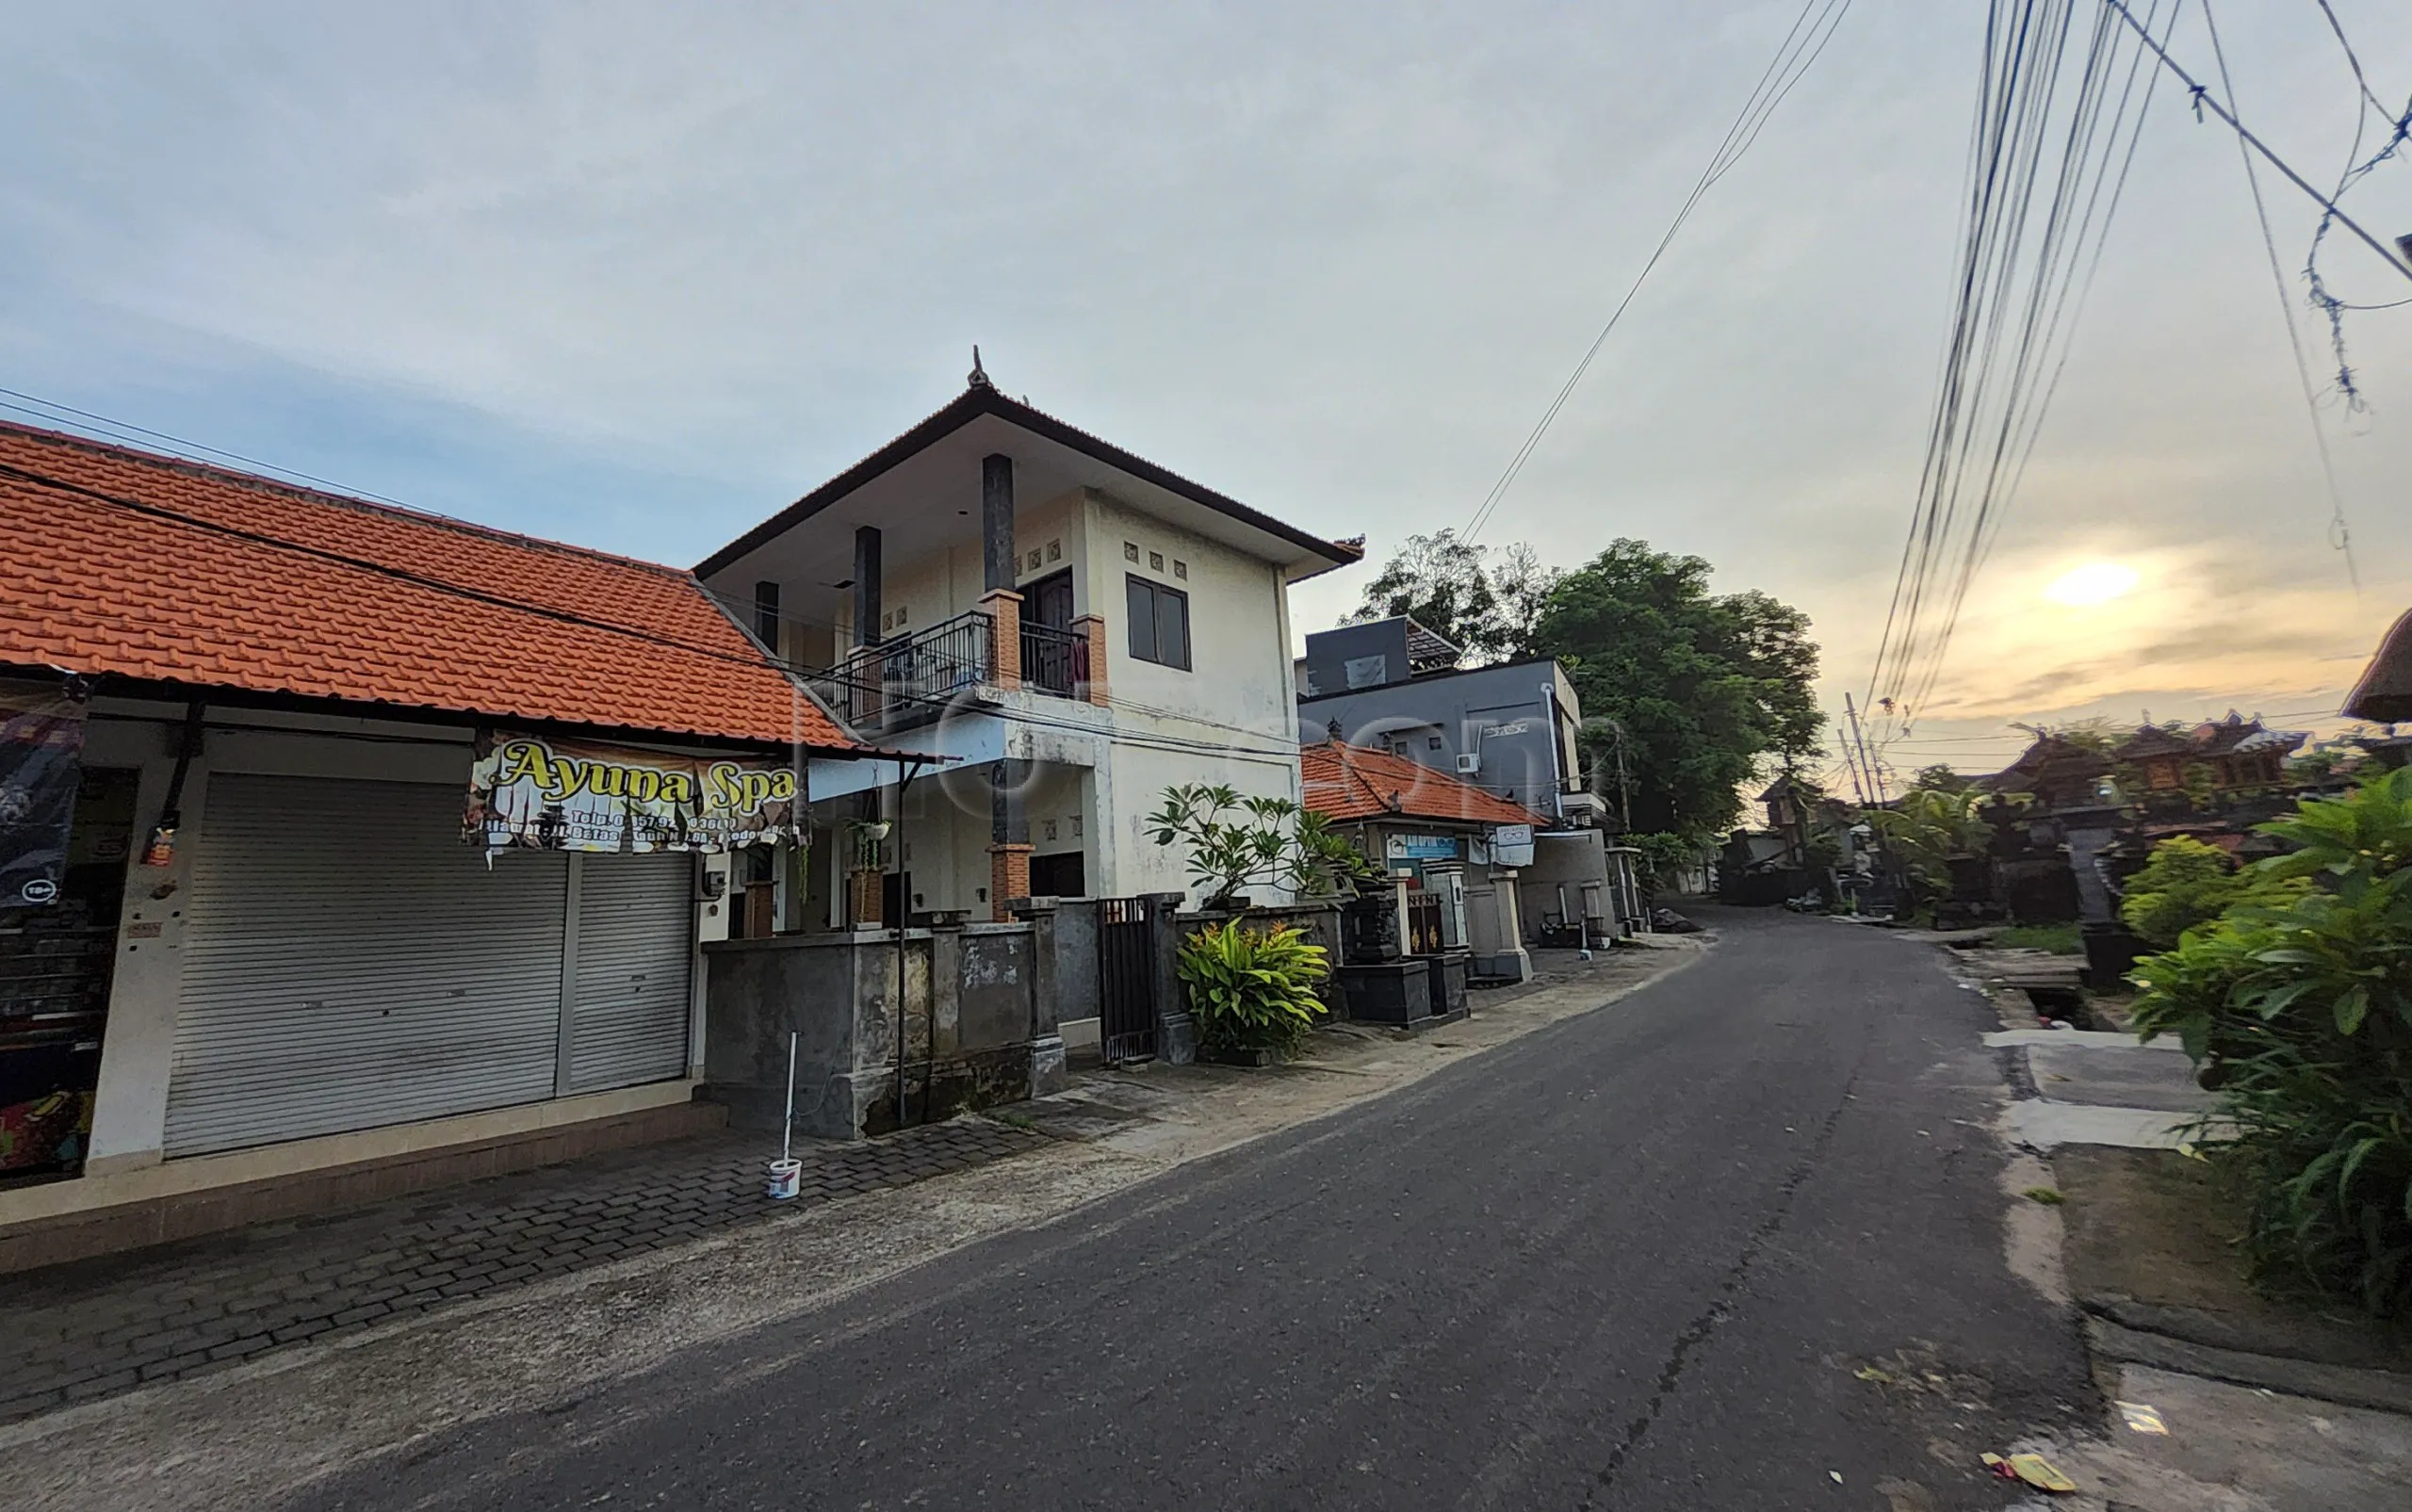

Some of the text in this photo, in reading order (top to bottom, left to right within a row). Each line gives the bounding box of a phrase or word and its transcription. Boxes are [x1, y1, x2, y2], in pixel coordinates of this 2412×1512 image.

[488, 740, 798, 816] Ayuna Spa
[571, 825, 619, 841] Batas
